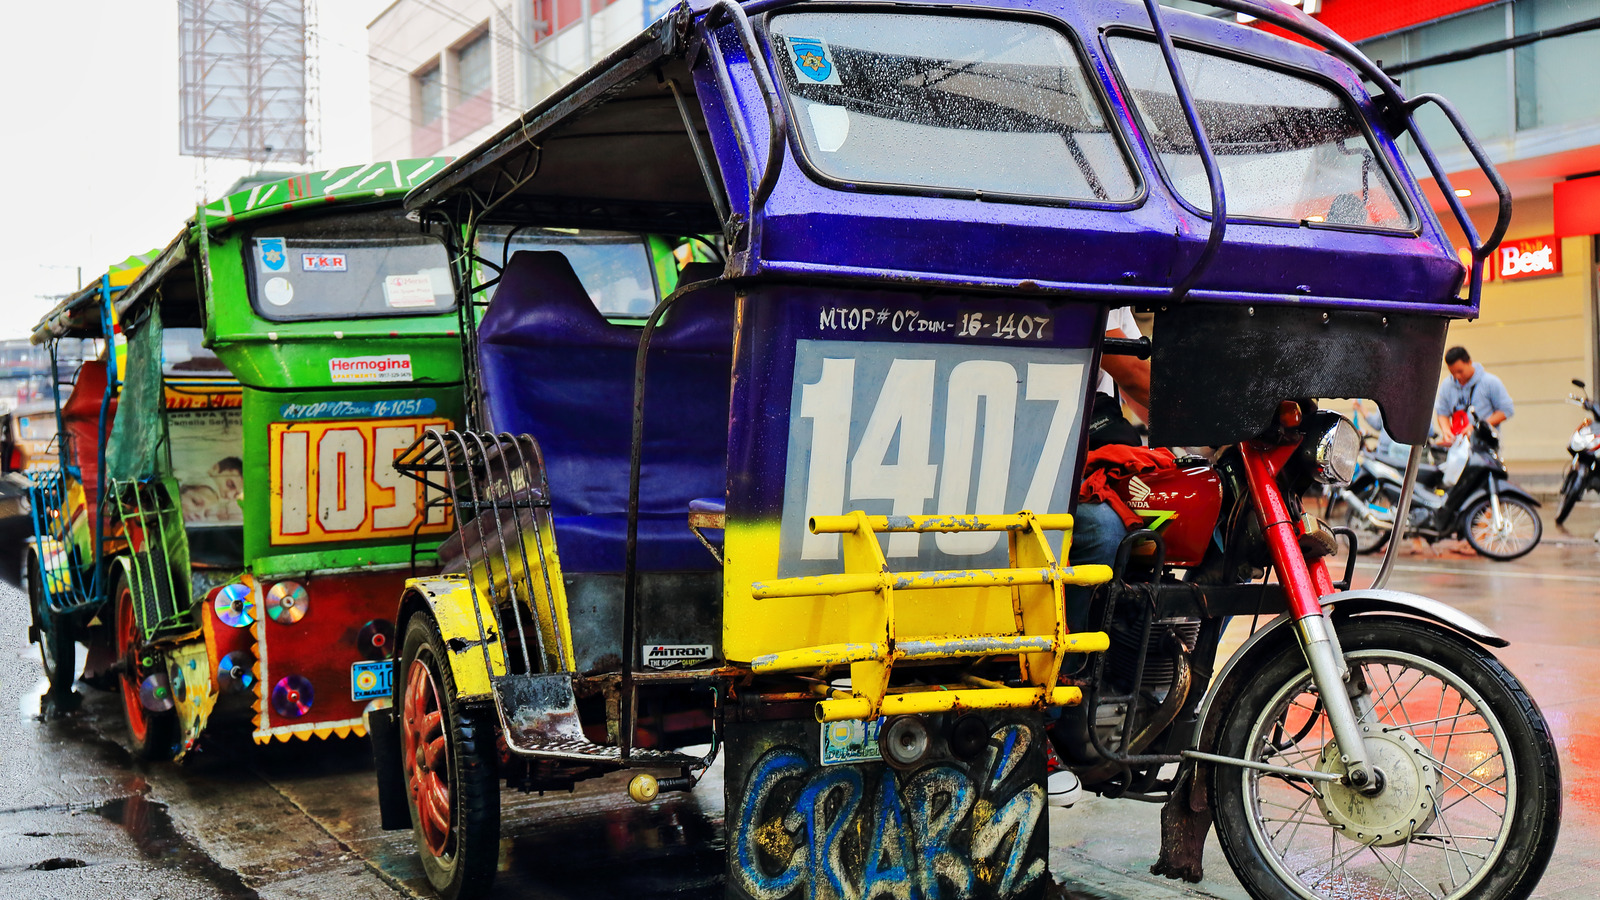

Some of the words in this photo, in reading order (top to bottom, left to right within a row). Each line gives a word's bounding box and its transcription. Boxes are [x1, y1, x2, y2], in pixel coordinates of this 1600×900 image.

[305, 257, 343, 267] TKR
[1501, 244, 1554, 276] Best
[331, 358, 410, 371] Hermogina
[800, 358, 1085, 560] 1407
[1126, 501, 1150, 509] ONDA
